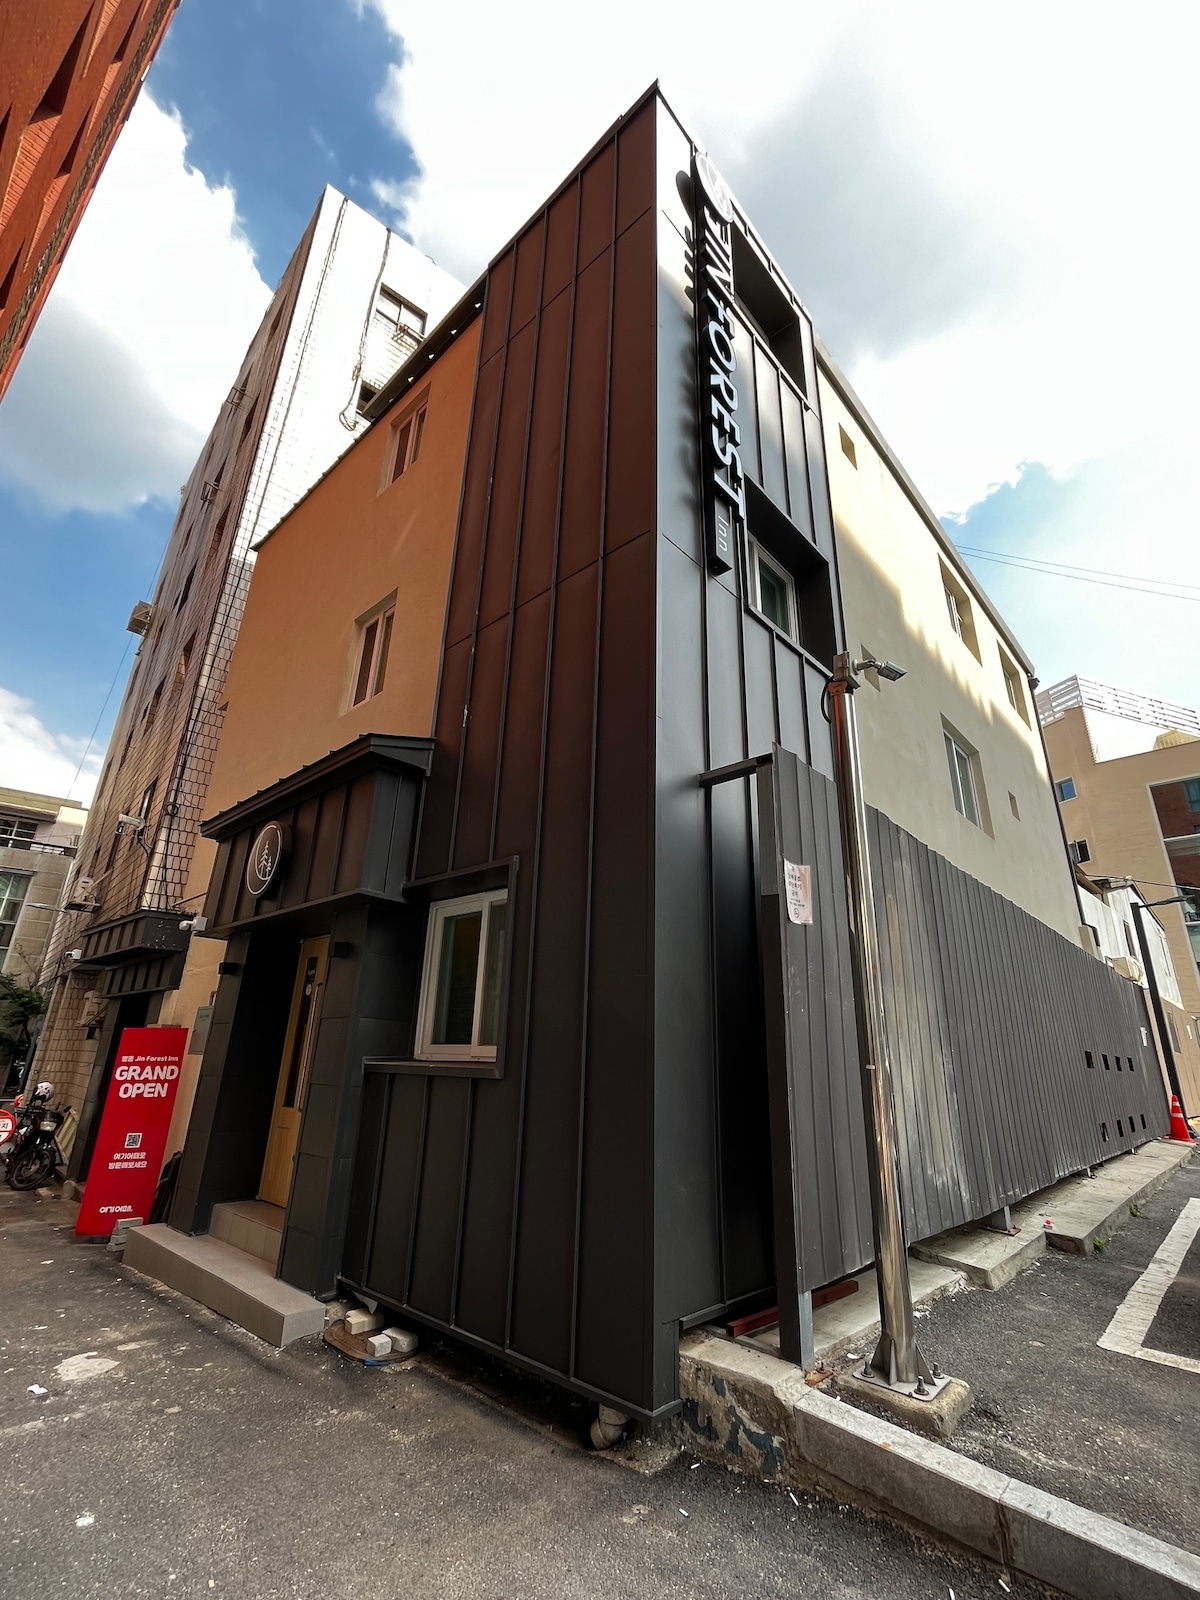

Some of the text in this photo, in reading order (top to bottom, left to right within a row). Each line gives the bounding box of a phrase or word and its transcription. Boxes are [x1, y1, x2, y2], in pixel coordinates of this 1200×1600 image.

[704, 205, 745, 552] JIN FOREST Inn
[115, 1065, 179, 1081] GRAND
[119, 1082, 169, 1099] OPEN
[113, 1152, 147, 1161] 여기어때로
[108, 1161, 148, 1170] 방문해보세요
